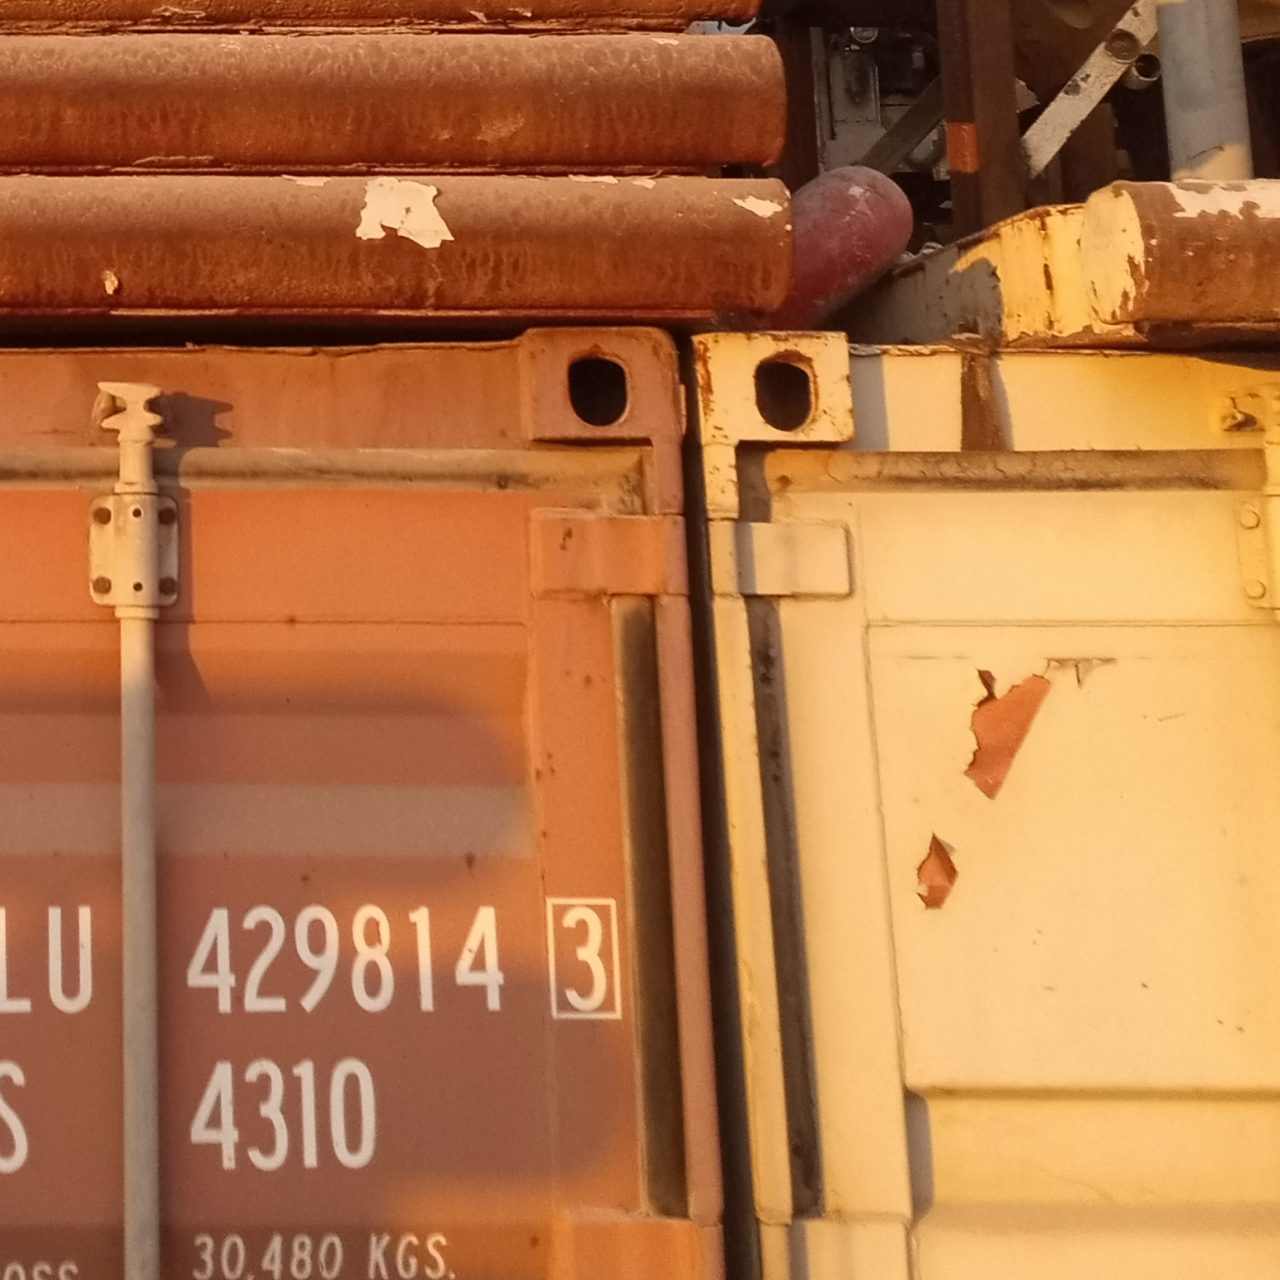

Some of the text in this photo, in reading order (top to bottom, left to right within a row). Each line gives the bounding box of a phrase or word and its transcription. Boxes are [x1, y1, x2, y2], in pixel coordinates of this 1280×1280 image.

[186, 904, 505, 1015] 429814
[561, 904, 607, 1013] 3
[190, 1058, 377, 1172] 4310
[367, 1232, 456, 1280] KGS.
